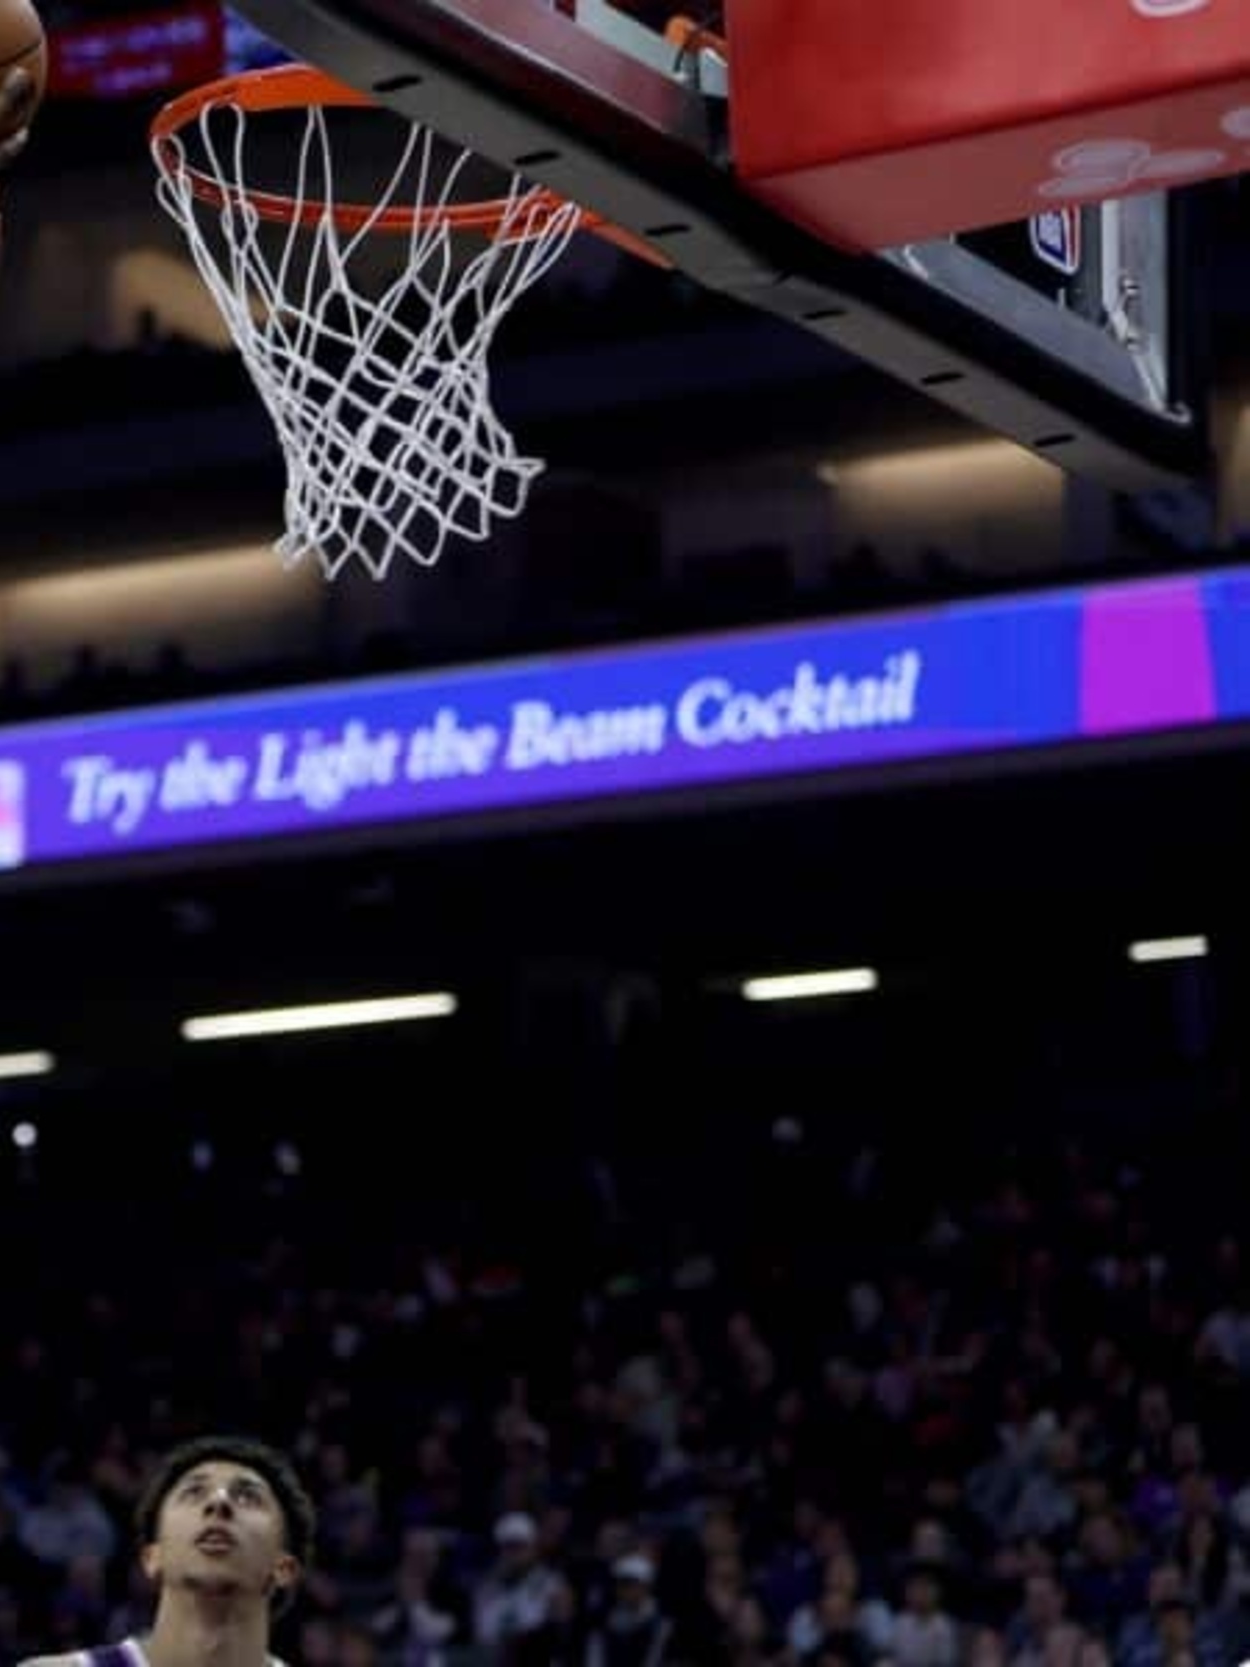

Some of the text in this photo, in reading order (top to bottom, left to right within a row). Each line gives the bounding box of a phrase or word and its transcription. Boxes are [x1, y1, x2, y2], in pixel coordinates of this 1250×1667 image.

[61, 755, 154, 834] Try
[160, 740, 247, 812] the
[255, 720, 401, 812] Light
[406, 708, 499, 782] the
[505, 700, 667, 771] Beam
[676, 649, 921, 748] Cocktail
